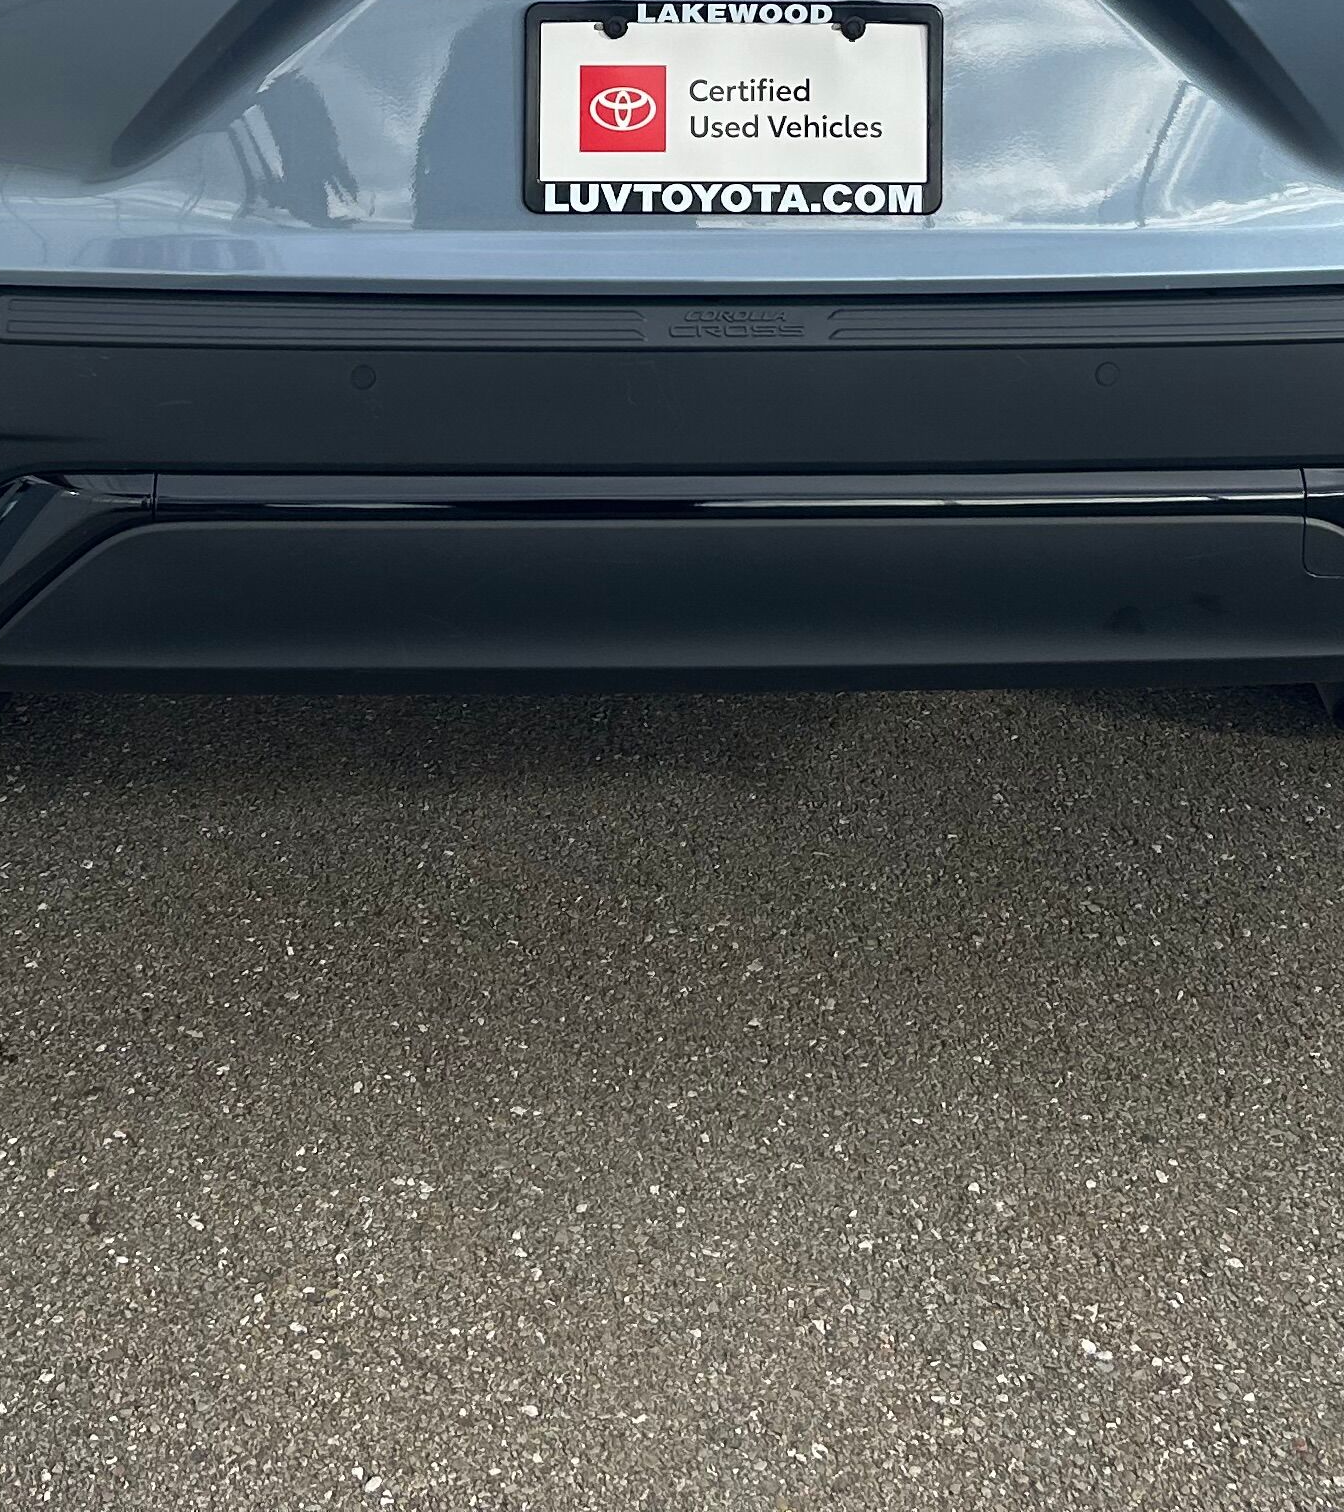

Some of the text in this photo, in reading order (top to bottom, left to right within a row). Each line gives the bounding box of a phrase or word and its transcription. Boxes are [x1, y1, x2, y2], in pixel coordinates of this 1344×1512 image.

[637, 2, 833, 24] LAKEWOOD
[688, 78, 811, 103] Certified
[689, 114, 883, 139] Used Vehicles
[544, 183, 923, 213] LUVTOYOTA.COM
[684, 309, 787, 323] COROLLA
[668, 325, 805, 338] CROSS
